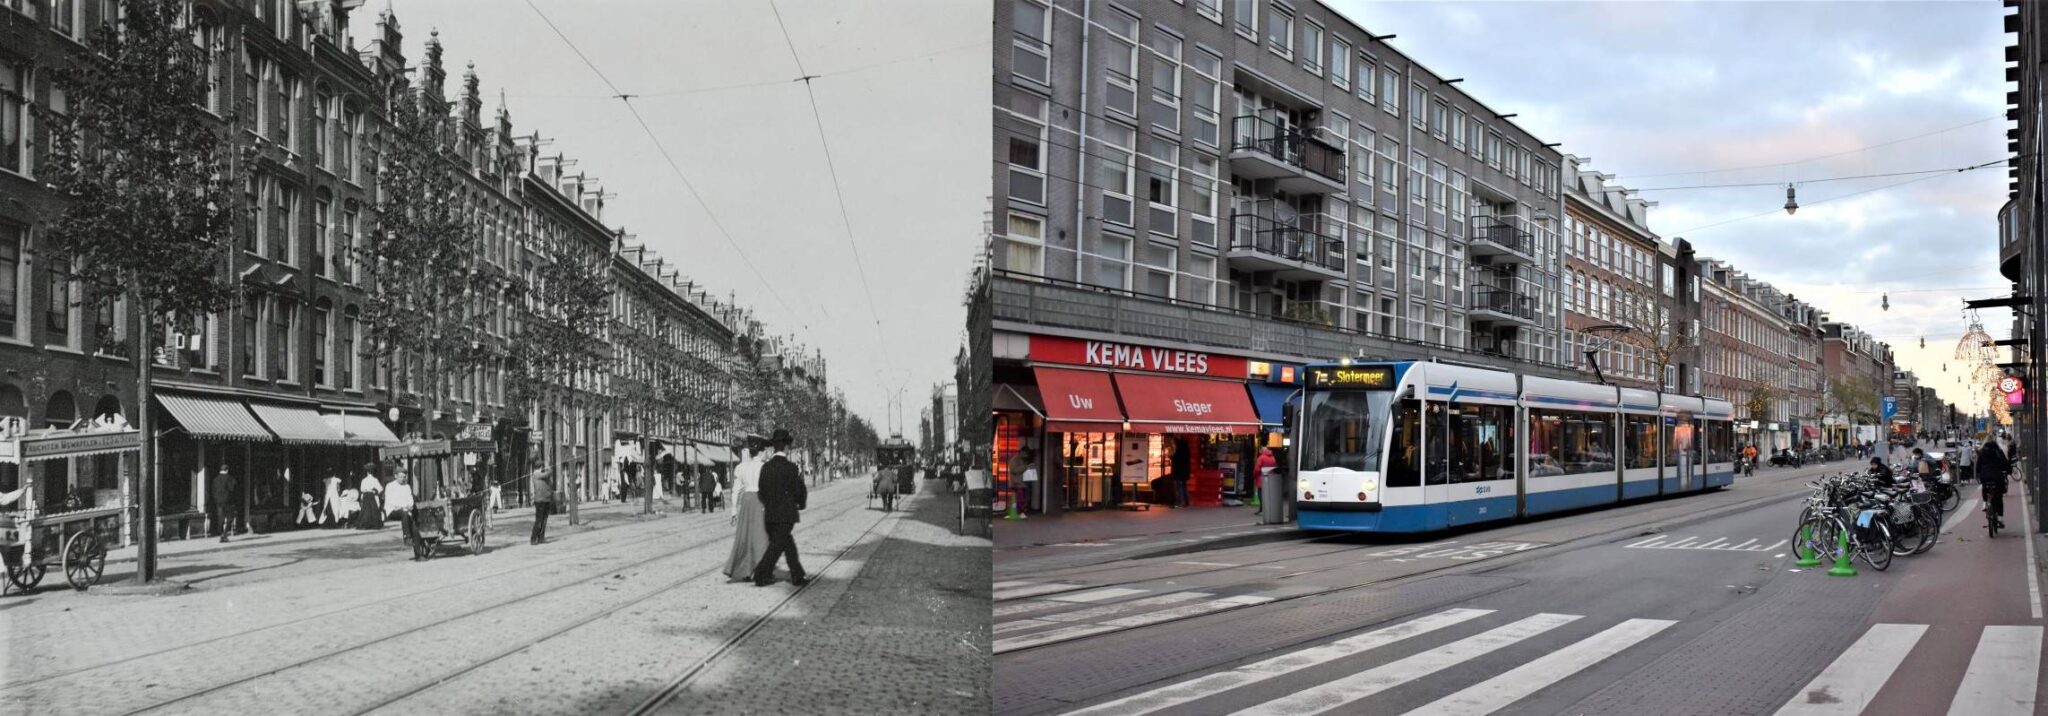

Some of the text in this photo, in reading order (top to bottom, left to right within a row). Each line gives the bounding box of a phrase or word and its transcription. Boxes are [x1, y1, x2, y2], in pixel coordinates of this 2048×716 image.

[1086, 341, 1208, 374] KEMA VLEES
[1337, 370, 1384, 382] Slotermeer
[1069, 394, 1093, 409] Uw
[1174, 399, 1212, 415] Slager
[1887, 402, 1893, 412] P
[1165, 424, 1233, 433] www.kemavlees.nl
